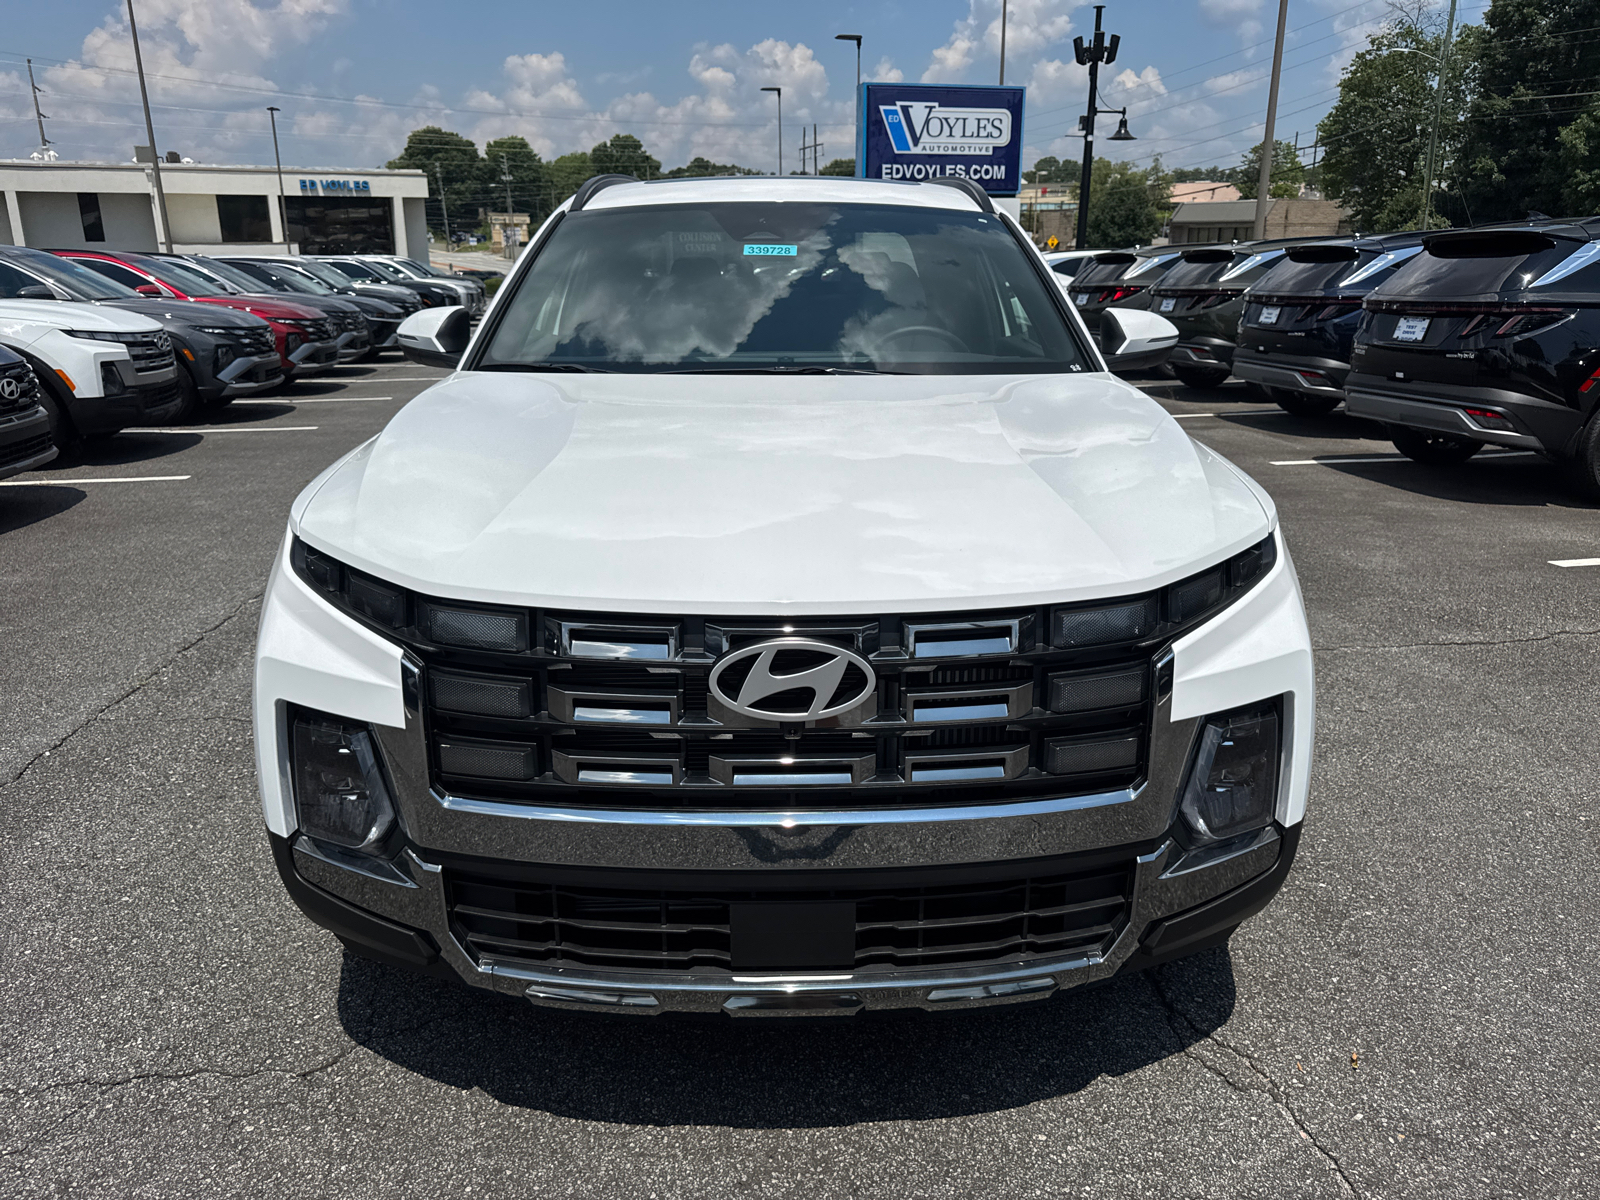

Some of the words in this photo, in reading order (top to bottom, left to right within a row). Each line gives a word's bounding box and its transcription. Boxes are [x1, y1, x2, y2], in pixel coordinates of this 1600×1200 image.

[888, 115, 899, 123] ED
[921, 145, 991, 153] AUTOMOTIVE
[882, 164, 1006, 180] EDVOYLES.COM
[299, 179, 318, 190] ED
[320, 179, 370, 191] VOYLES
[685, 243, 717, 253] CENTER
[748, 246, 791, 255] 339728
